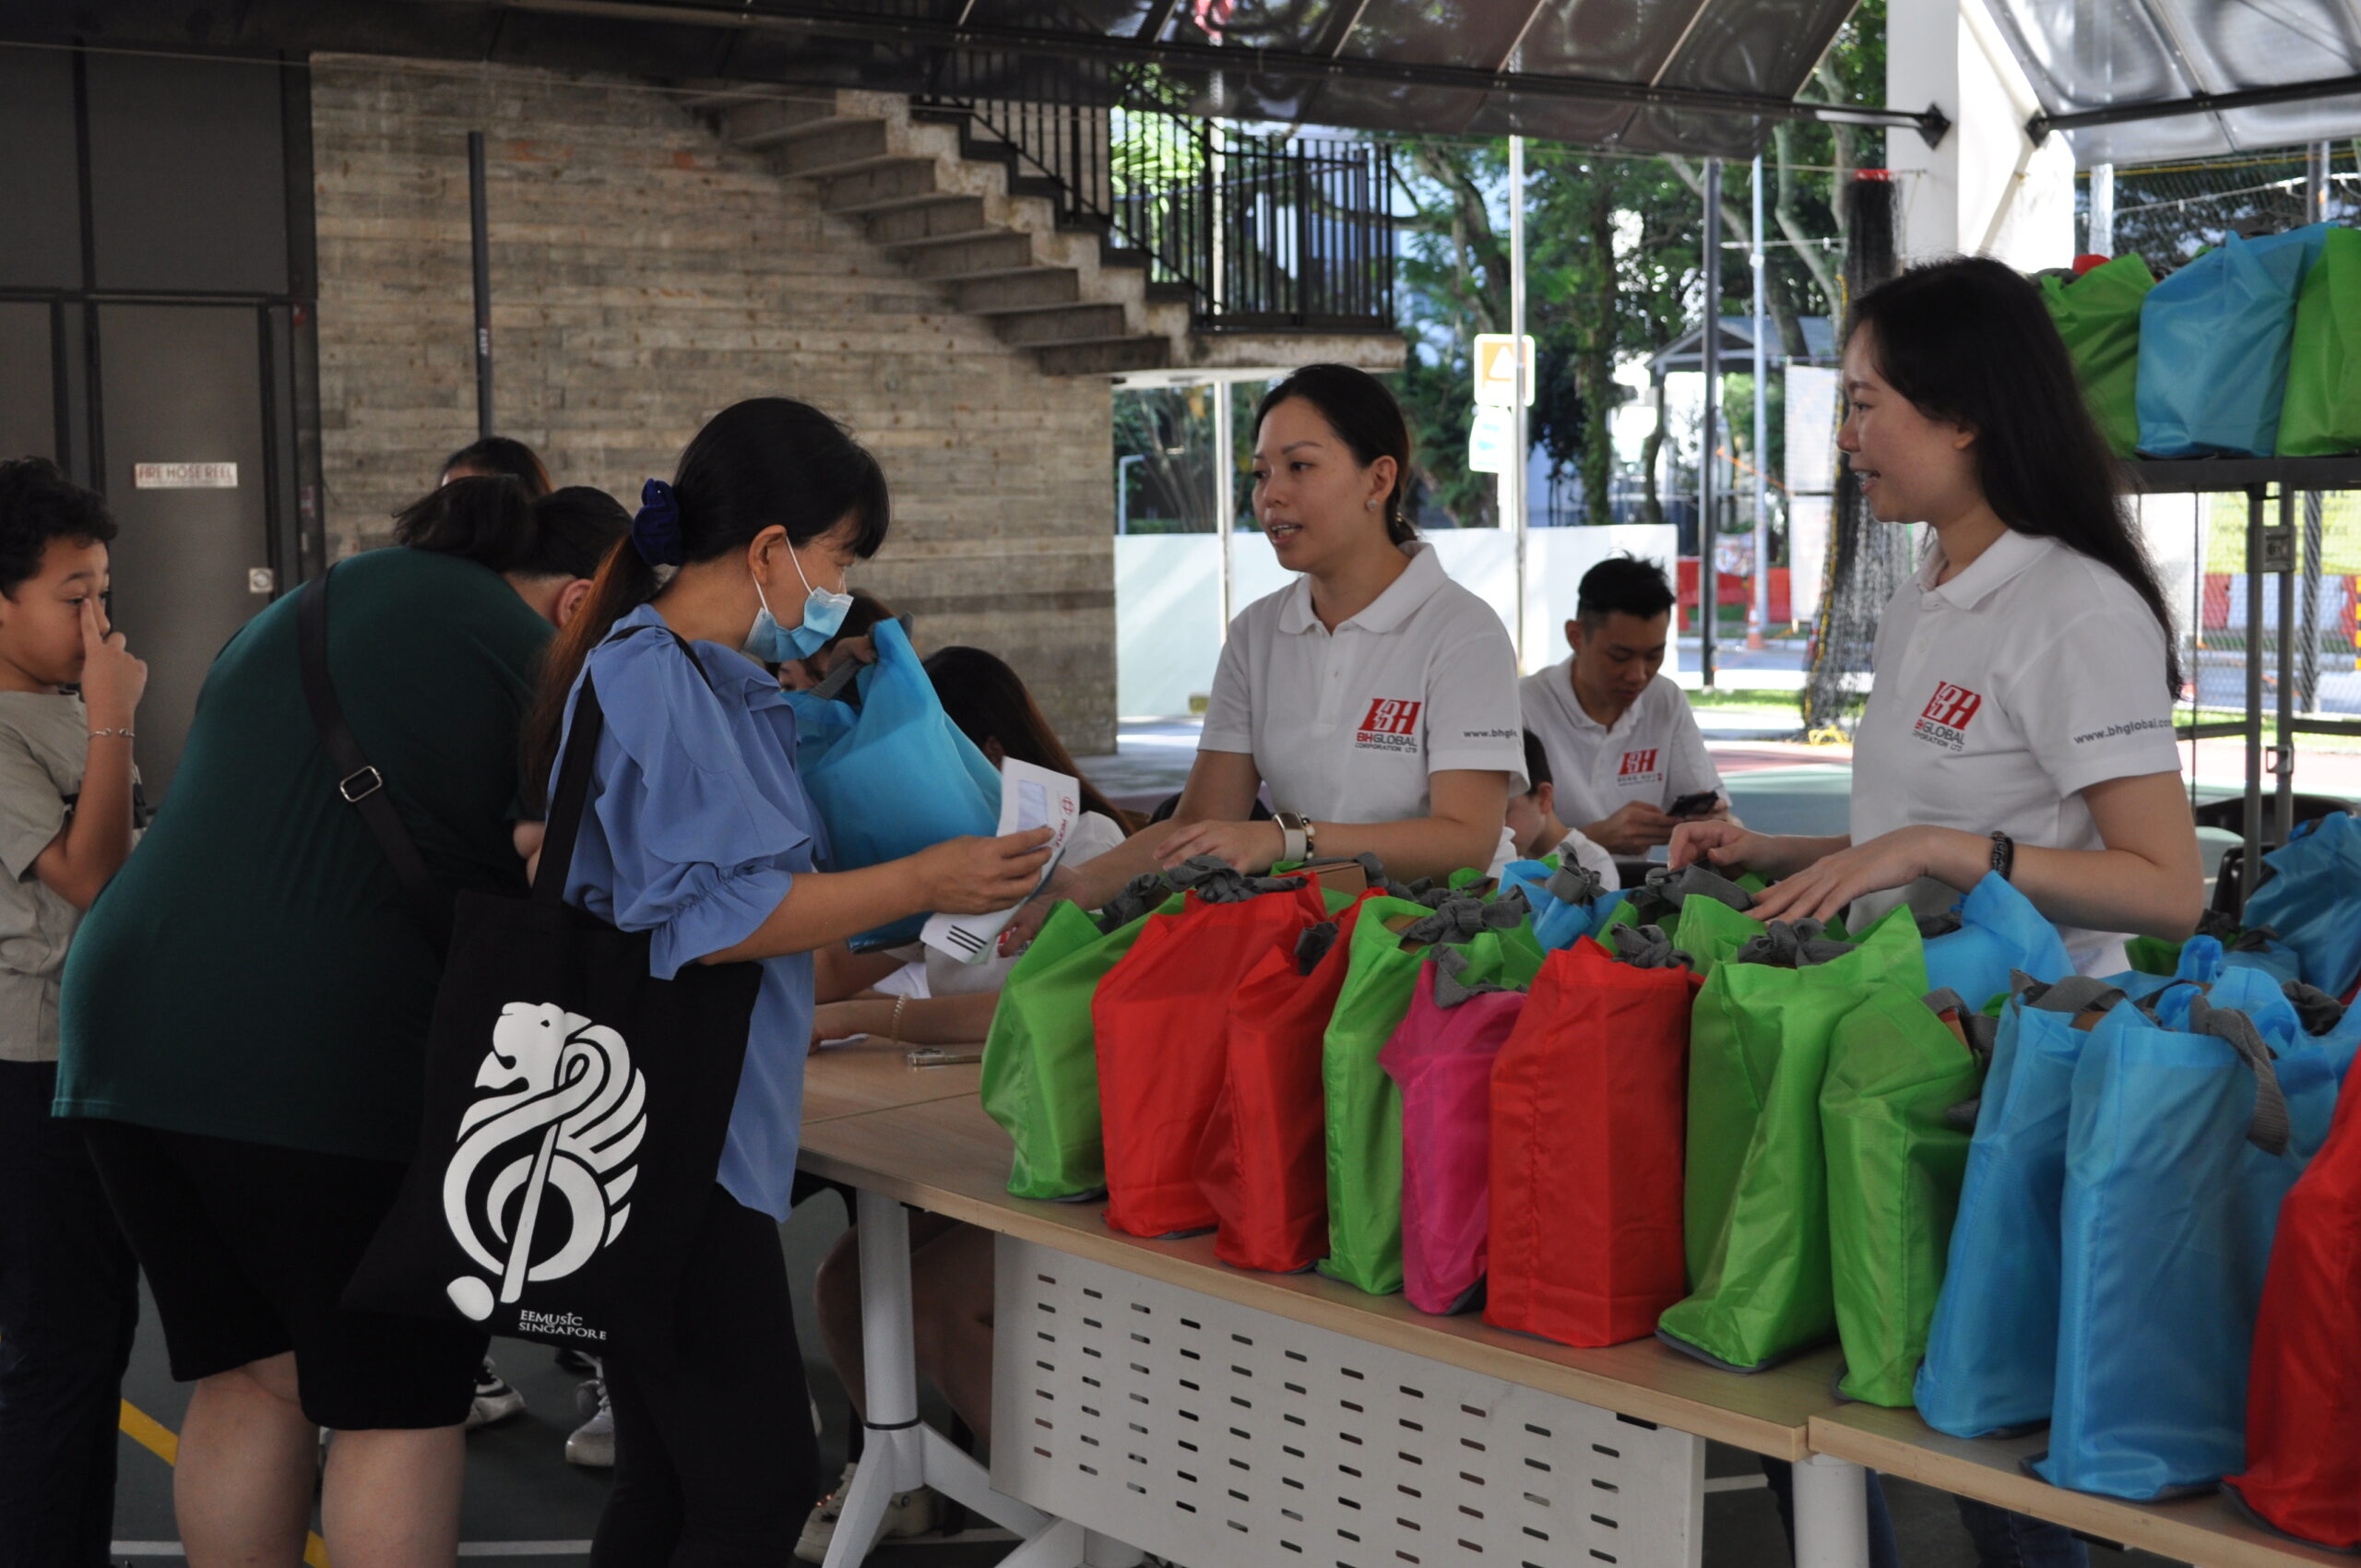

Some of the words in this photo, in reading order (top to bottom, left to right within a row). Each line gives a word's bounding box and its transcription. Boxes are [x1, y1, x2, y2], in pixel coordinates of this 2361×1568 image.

[138, 464, 161, 478] FIRE
[167, 464, 201, 478] HOSE
[205, 464, 232, 478] REEL
[1357, 732, 1418, 747] BHGLOBAL
[520, 1310, 583, 1326] EEMUSIC
[518, 1322, 607, 1340] SINGAPORE
